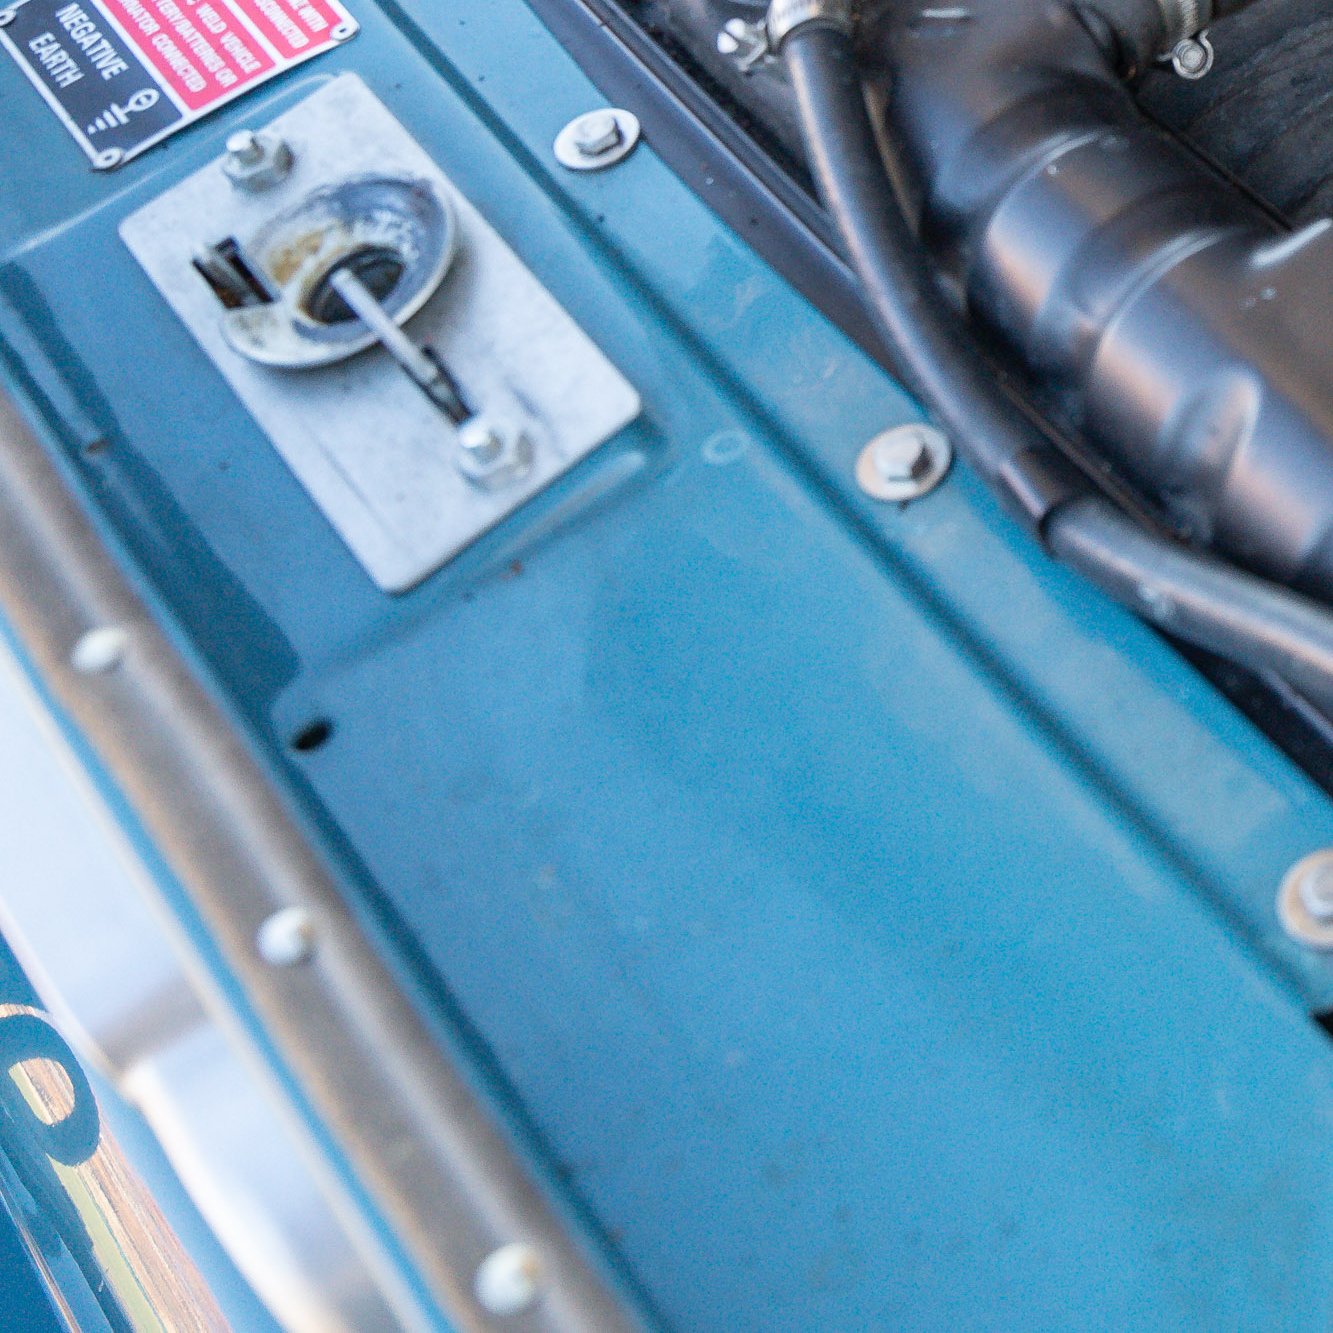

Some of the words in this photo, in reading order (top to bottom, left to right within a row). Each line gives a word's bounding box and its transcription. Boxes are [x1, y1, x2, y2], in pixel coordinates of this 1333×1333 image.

[28, 32, 85, 88] EARTH
[55, 2, 129, 80] NEGATIVE
[151, 33, 207, 92] CONNECTED
[196, 3, 227, 34] WELD
[220, 31, 262, 74] VEHICLE
[215, 67, 238, 88] OR
